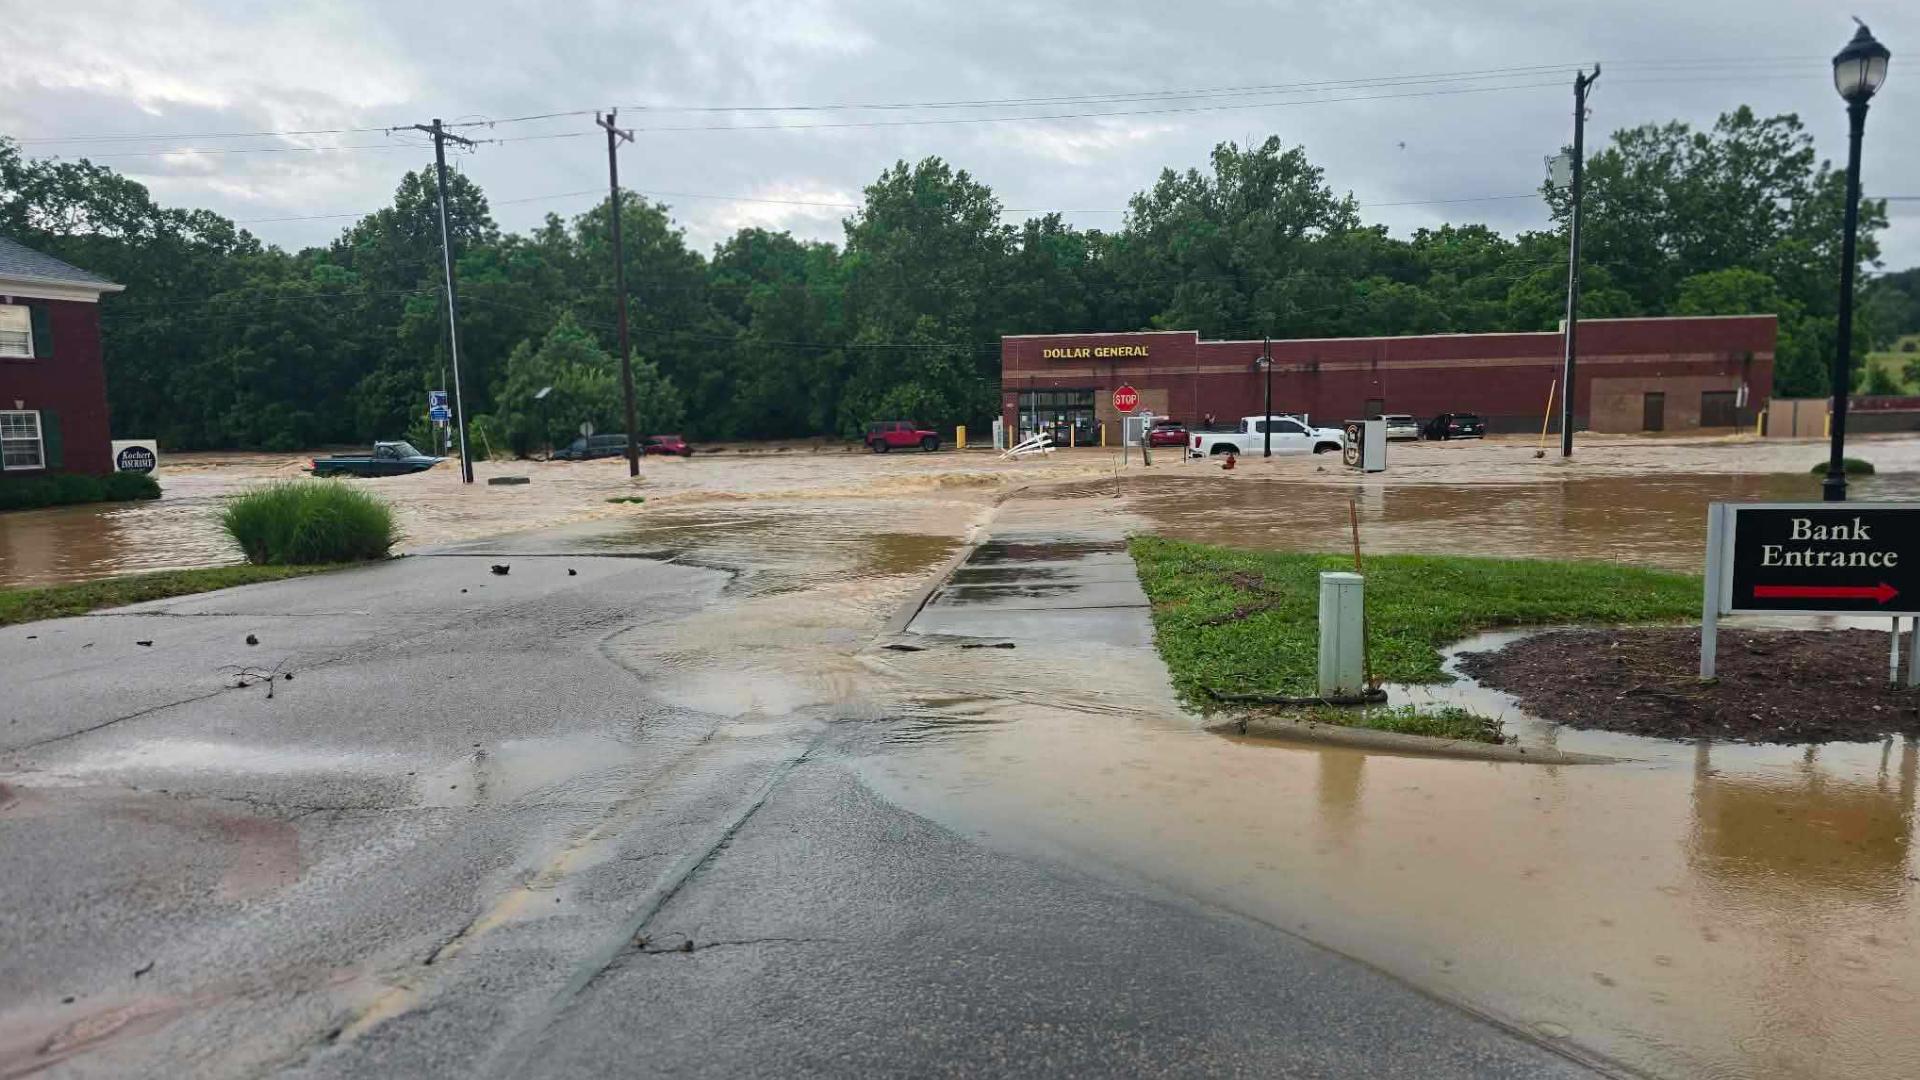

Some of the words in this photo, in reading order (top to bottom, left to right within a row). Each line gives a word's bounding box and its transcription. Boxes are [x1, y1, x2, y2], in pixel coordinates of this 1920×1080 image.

[1043, 348, 1090, 358] DOLLAR
[1094, 346, 1148, 357] GENERAL
[1115, 394, 1137, 405] STOP
[1789, 516, 1871, 541] Bank
[1760, 544, 1899, 568] Entrance
